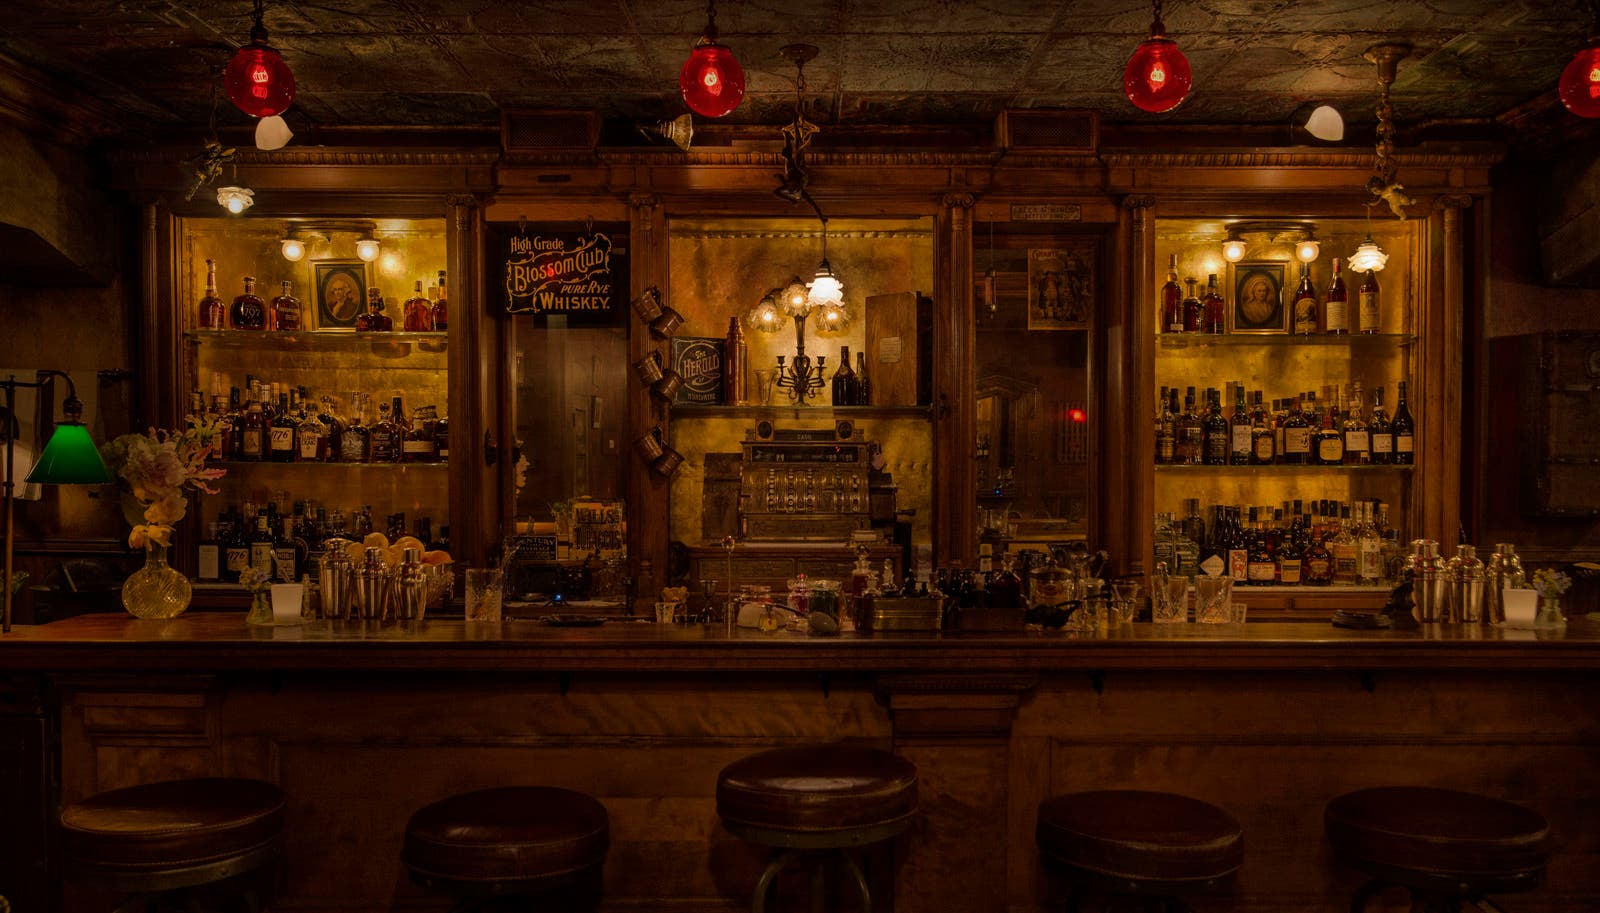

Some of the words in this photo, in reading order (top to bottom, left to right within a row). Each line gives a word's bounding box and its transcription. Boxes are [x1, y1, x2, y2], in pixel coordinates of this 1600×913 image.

[510, 236, 532, 254] High
[533, 235, 564, 250] Grade
[514, 257, 575, 292] Blossom
[575, 247, 604, 273] Club
[561, 284, 586, 294] PURE
[586, 280, 610, 294] RYE
[540, 292, 610, 310] WHISKEY.
[683, 353, 720, 379] HEROLD
